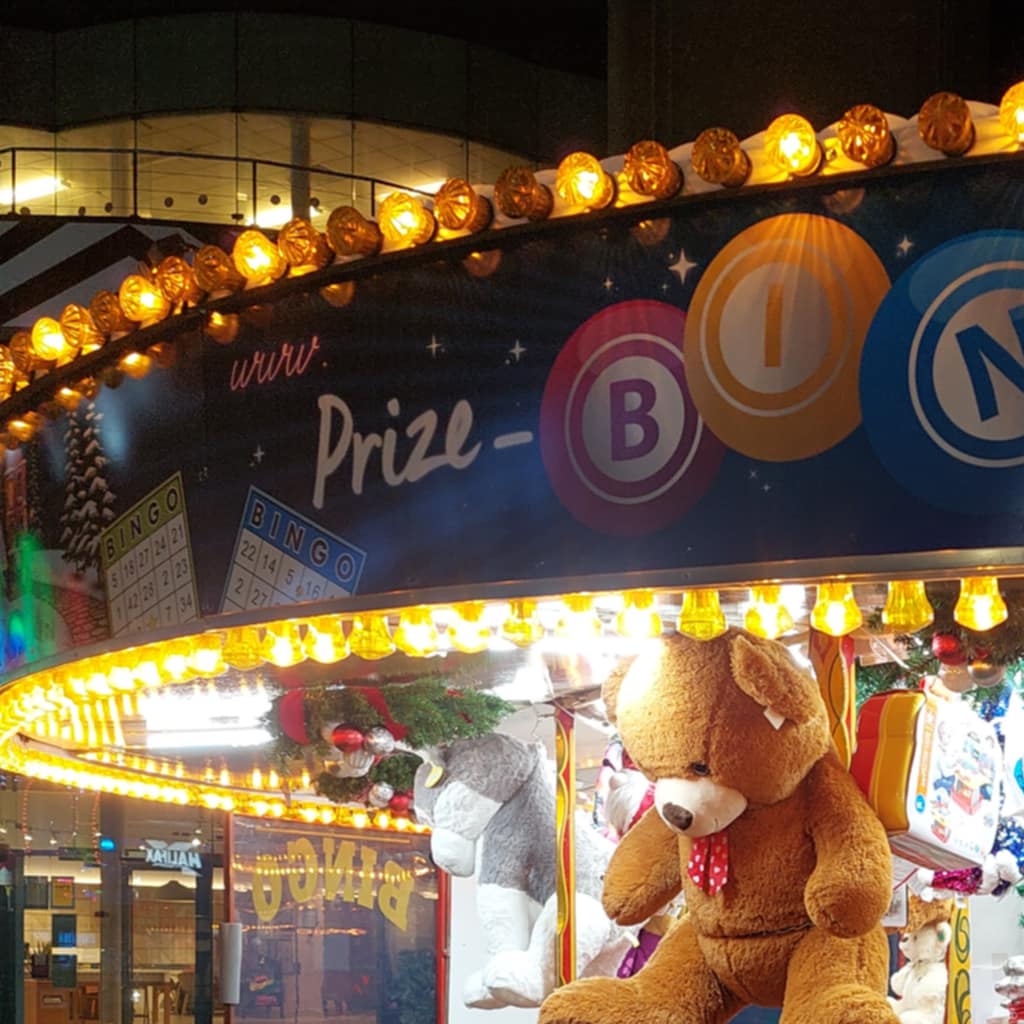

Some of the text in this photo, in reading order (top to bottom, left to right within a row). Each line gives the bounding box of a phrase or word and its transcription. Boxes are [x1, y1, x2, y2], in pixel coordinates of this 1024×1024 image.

[229, 335, 329, 392] www.
[107, 488, 178, 562] BINGO
[171, 525, 184, 544] 21
[250, 498, 355, 583] BINGO
[162, 569, 169, 587] 2
[235, 577, 243, 595] 2
[240, 539, 255, 562] 22
[263, 554, 277, 575] 14
[285, 568, 294, 586] 5
